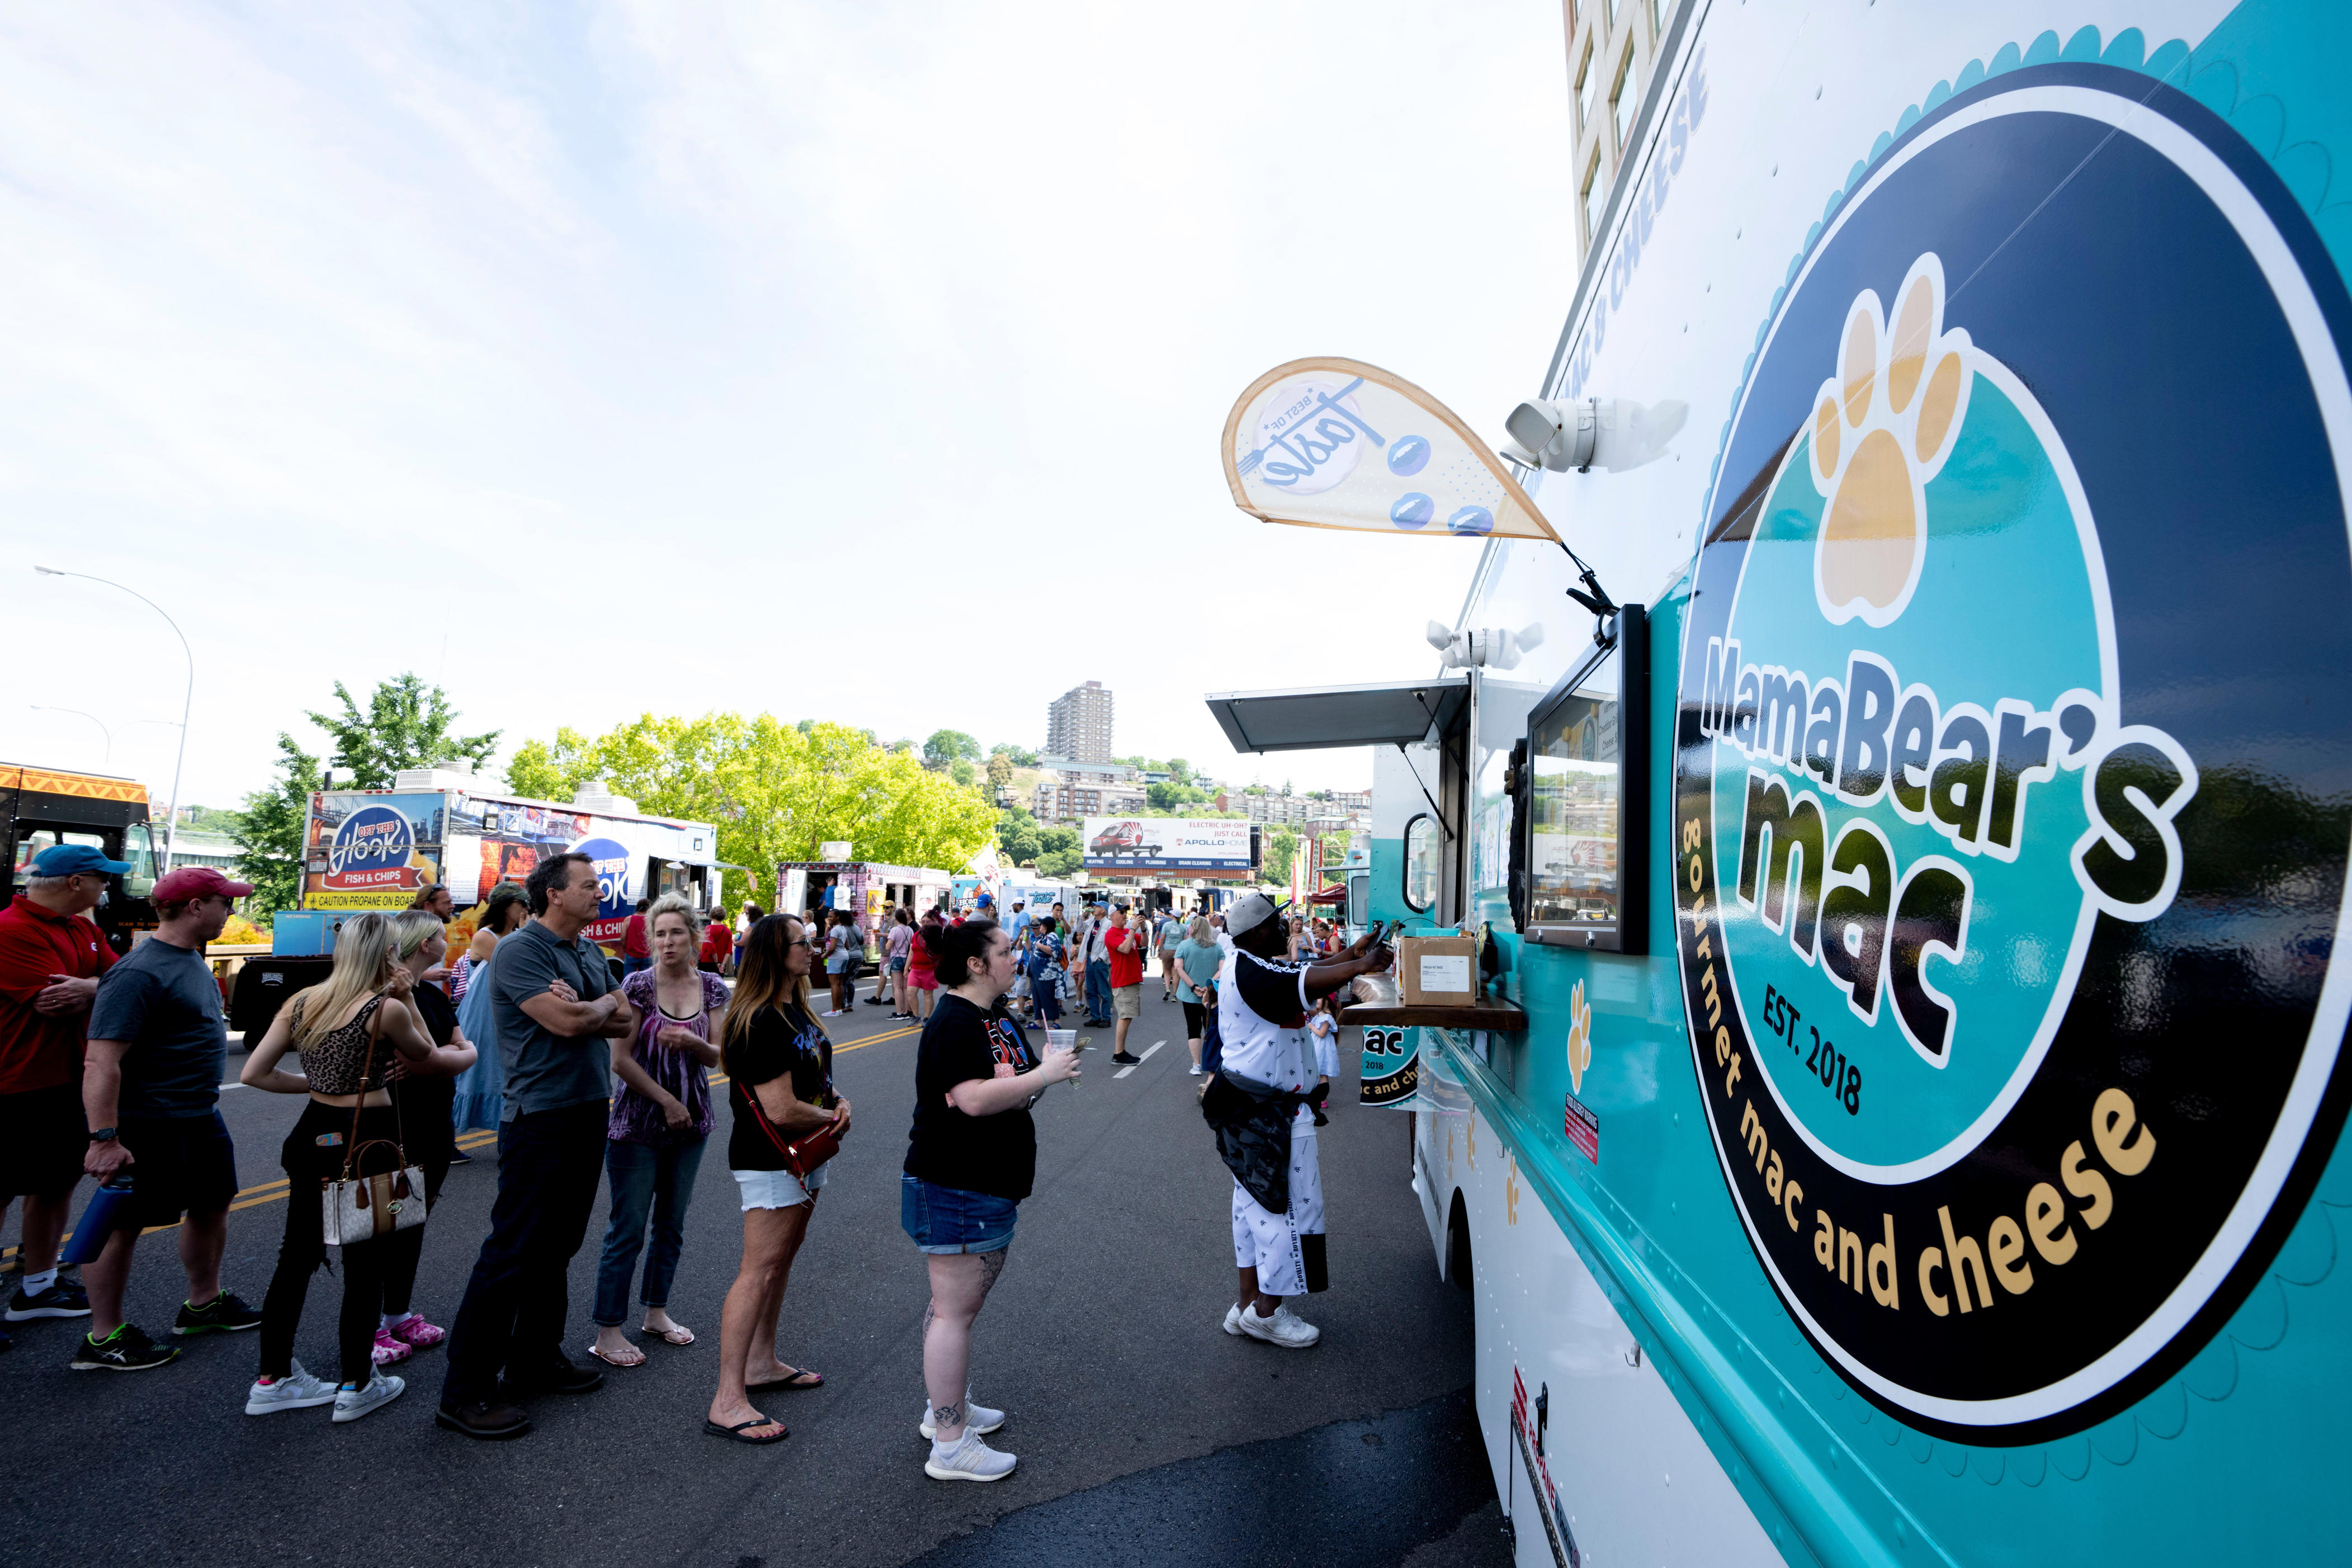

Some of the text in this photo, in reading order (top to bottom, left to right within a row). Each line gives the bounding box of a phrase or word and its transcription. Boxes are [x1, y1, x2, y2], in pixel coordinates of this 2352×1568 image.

[1594, 294, 1607, 355] &
[1610, 41, 1710, 315] CHEESE
[1701, 641, 2191, 909] MamaBear's
[358, 821, 395, 837] OFF THE
[606, 859, 624, 872] THE
[345, 871, 402, 884] FISH & CHIPS
[319, 896, 415, 906] CAUTION PROPANE ON BOAR
[1028, 891, 1055, 906] Taste
[1738, 774, 1967, 1057] mac
[596, 924, 602, 934] &
[1763, 983, 1862, 1116] EST. 2018
[1366, 1061, 1383, 1070] 2018
[1683, 818, 1742, 1098] gourmet
[1740, 1101, 1803, 1232] mac
[1814, 1209, 1900, 1311] and
[1919, 1088, 2156, 1316] cheese
[1375, 1078, 1400, 1094] and
[1573, 1099, 1585, 1118] ALLERGY
[1584, 1108, 1597, 1129] WARNING
[1291, 1230, 1299, 1252] ROYALTY
[1295, 1260, 1304, 1283] ROYALTY
[1559, 1511, 1573, 1565] Smoking
